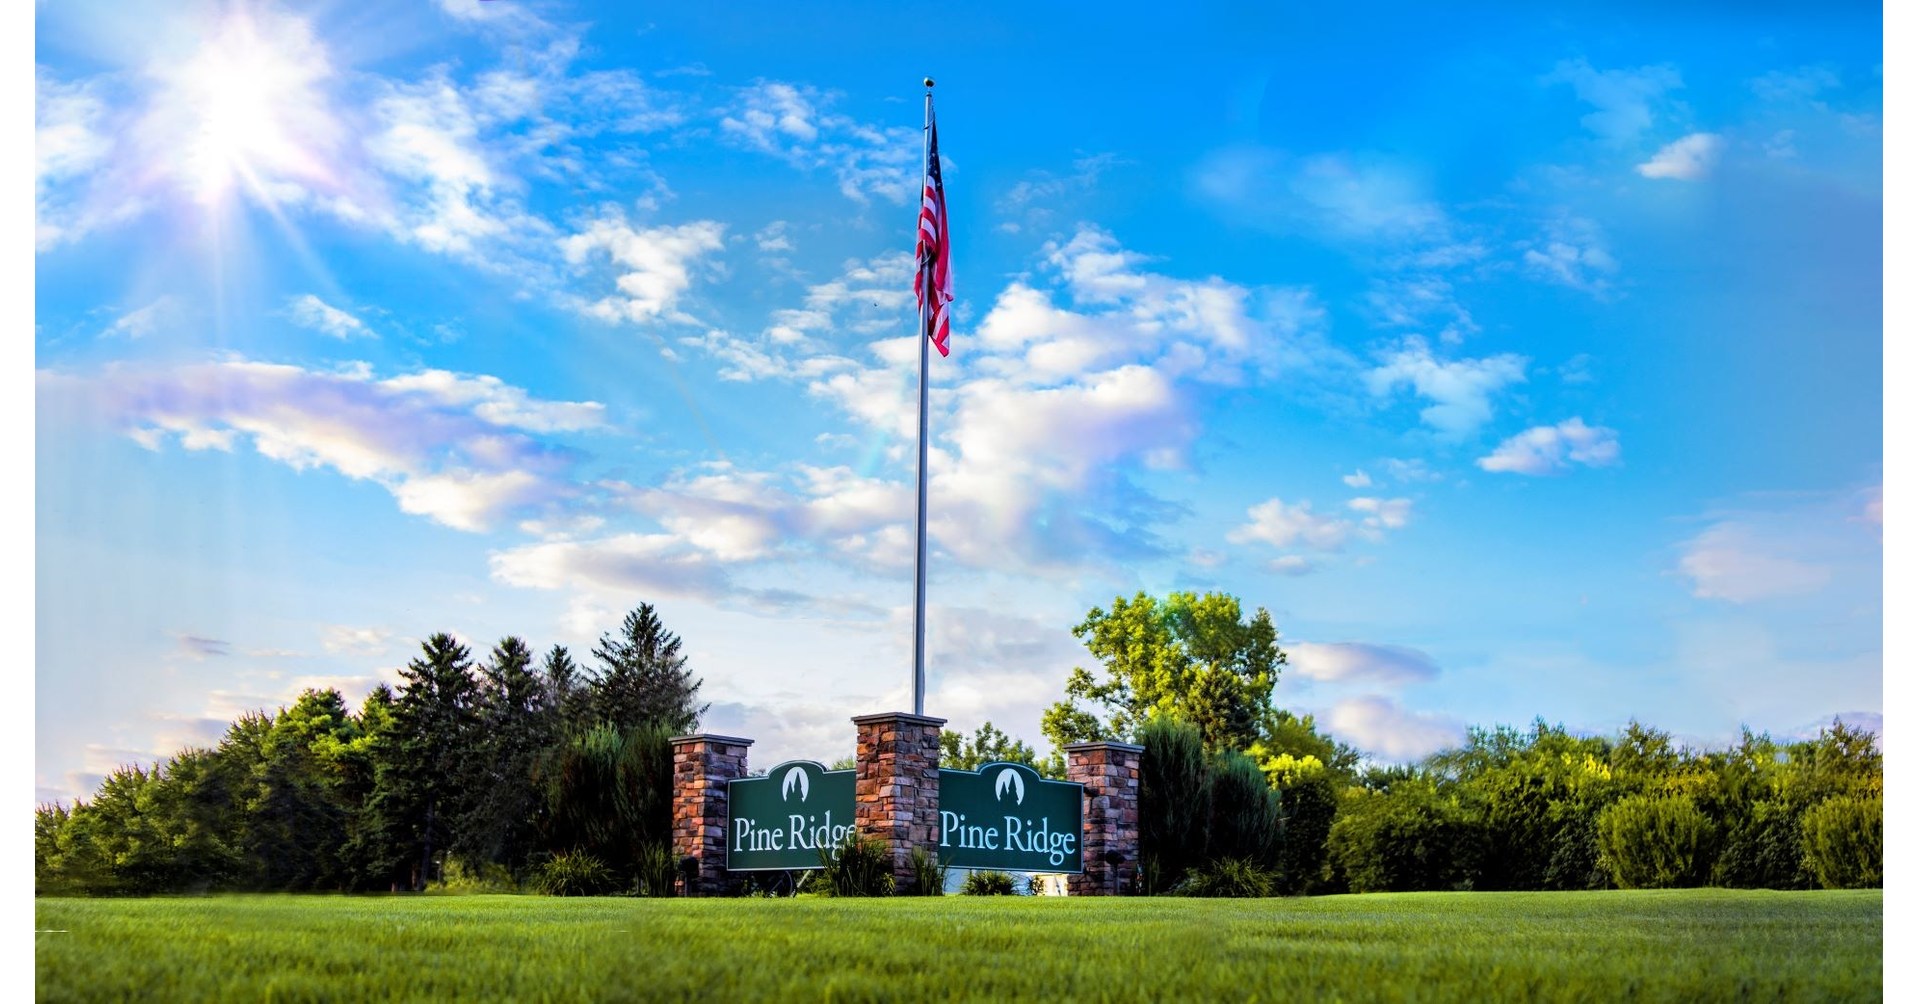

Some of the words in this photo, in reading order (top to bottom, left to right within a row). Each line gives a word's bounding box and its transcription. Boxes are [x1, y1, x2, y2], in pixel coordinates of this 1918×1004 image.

[734, 817, 783, 852] Pine
[788, 810, 856, 861] Ridge
[939, 810, 999, 849] Pine
[1003, 816, 1075, 866] Ridge
